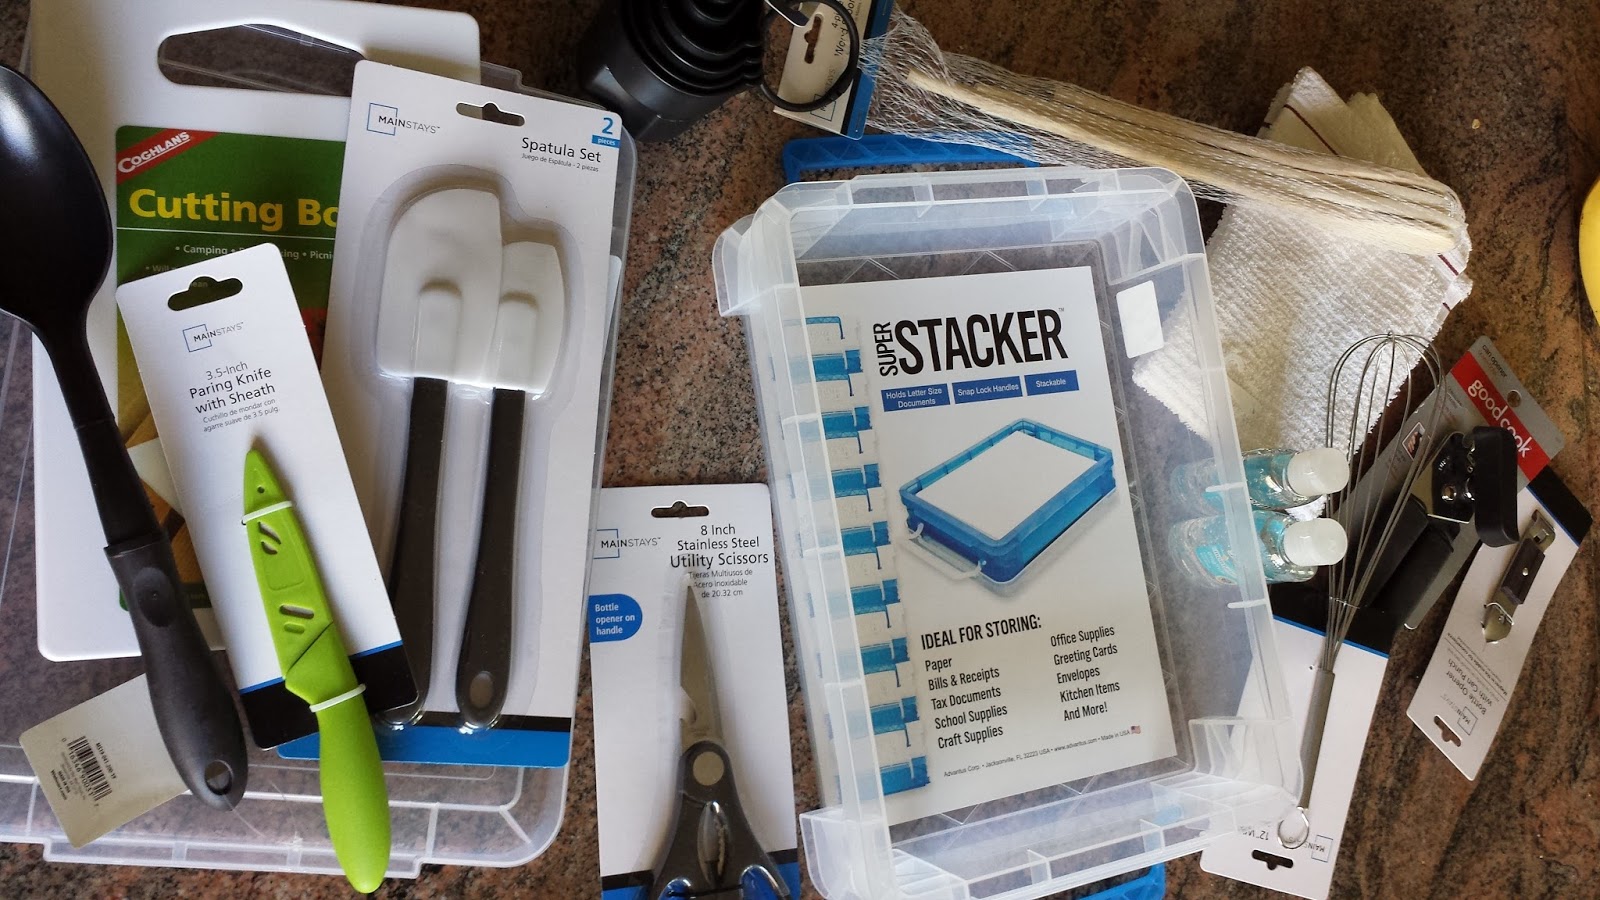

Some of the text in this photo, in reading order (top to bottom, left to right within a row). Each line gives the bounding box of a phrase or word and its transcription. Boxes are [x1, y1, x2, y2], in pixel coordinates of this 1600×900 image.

[379, 115, 438, 134] MAINSTAYS
[601, 117, 613, 135] 2
[522, 137, 601, 162] Spatula Set
[598, 137, 615, 146] pieces
[118, 132, 190, 173] COGHLANS
[522, 153, 538, 161] Juego
[129, 189, 283, 231] Cutting
[184, 245, 228, 255] Camping
[310, 251, 333, 260] Picni
[194, 324, 242, 342] MAINSTAYS
[873, 322, 898, 377] SUPER
[895, 309, 1069, 374] STACKER
[206, 361, 248, 380] 3.5-Inch
[190, 368, 271, 398] Paring Knife
[958, 383, 1019, 397] Snap Lock Handles
[1036, 378, 1066, 387] Stackable
[195, 383, 275, 413] with Sheath
[886, 391, 906, 400] Holds
[908, 389, 926, 398] Letter
[898, 398, 936, 408] Documents
[203, 412, 228, 423] Cuchillo
[230, 408, 237, 416] de
[239, 402, 262, 413] mondar
[204, 423, 223, 432] agarre
[225, 418, 242, 426] suave
[701, 524, 735, 535] 8 Inch
[601, 538, 658, 548] MAINSTAYS
[678, 536, 759, 550] Stainless Steel
[671, 552, 768, 570] Utility Scissors
[712, 569, 742, 577] Multiusos
[595, 602, 619, 612] Bottle
[596, 614, 623, 624] opener
[597, 625, 623, 635] handle
[921, 614, 1042, 650] IDEAL FOR STORING:
[1050, 625, 1115, 647] Office Supplies
[1054, 643, 1117, 665] Greeting Cards
[925, 657, 952, 674] Paper
[928, 667, 1000, 691] Bills & Receipts
[1057, 667, 1100, 684] Envelopes
[1445, 670, 1468, 695] Opener
[1448, 658, 1493, 707] with Can Punch
[931, 686, 1001, 710] Tax Documents
[1060, 681, 1120, 702] Kitchen Items
[1064, 702, 1108, 721] And More!
[1469, 694, 1487, 715] Bottle
[935, 705, 1007, 729] School Supplies
[938, 725, 1003, 749] Craft Supplies
